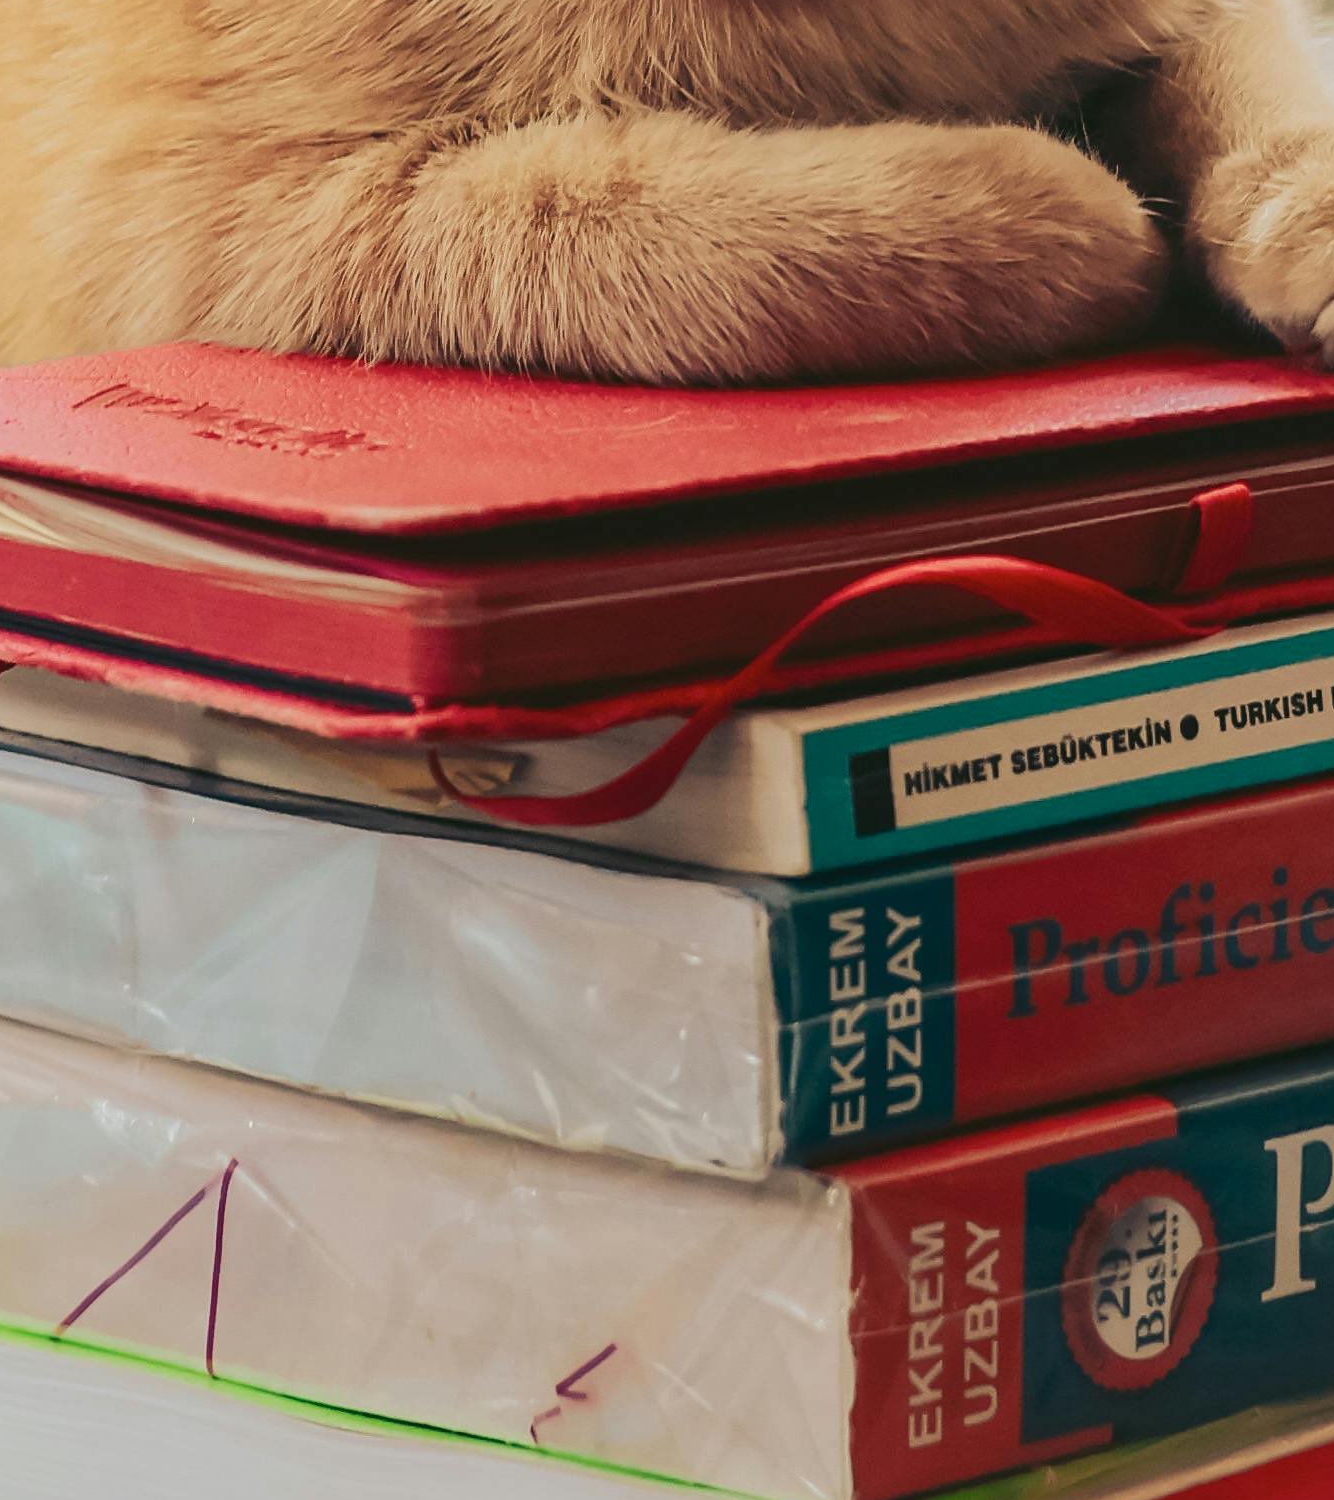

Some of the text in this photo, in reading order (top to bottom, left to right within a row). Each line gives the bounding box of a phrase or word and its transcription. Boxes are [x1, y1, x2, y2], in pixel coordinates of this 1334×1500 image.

[903, 752, 1001, 798] HİKMET
[1011, 715, 1173, 775] SEBÜKTEKİN
[1214, 688, 1324, 735] TURKISH
[829, 906, 866, 1137] EKREM
[885, 907, 923, 1118] UZBAY
[908, 1219, 946, 1449] EKREM
[962, 1220, 1001, 1426] UZBAY
[1135, 1208, 1167, 1353] Baskı
